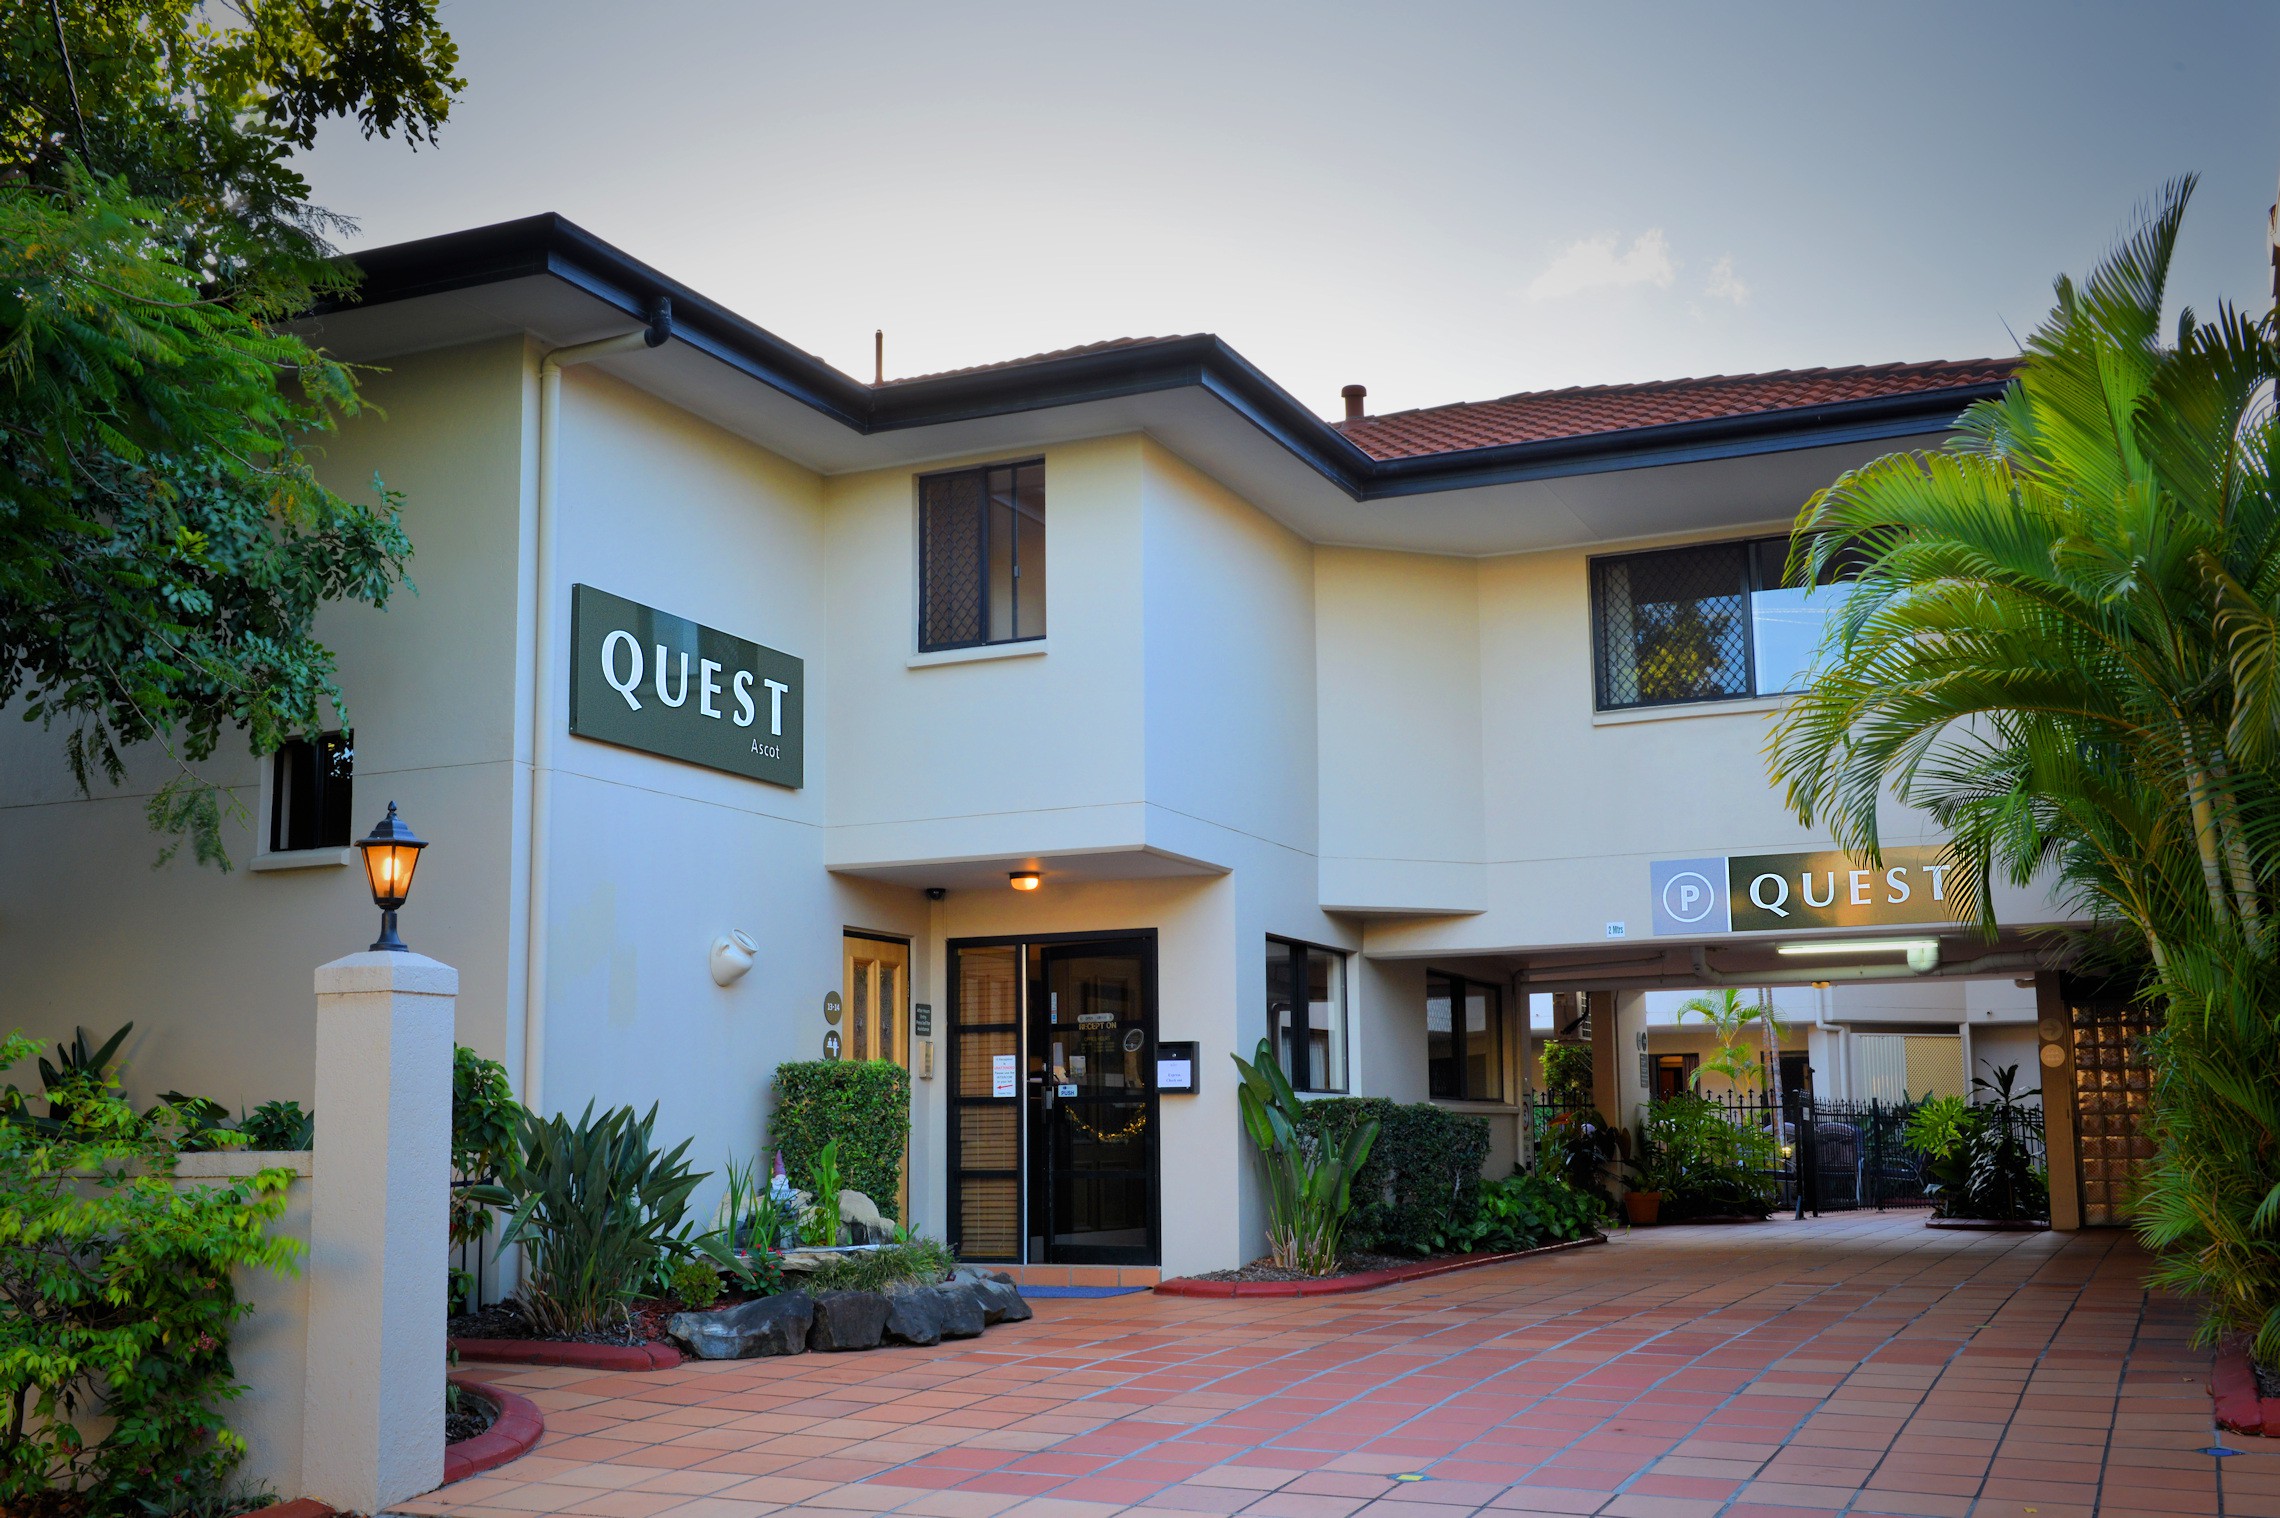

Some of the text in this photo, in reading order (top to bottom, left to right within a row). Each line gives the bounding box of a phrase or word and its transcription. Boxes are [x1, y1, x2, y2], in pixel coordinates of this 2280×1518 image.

[602, 630, 788, 735] QUEST
[750, 738, 780, 759] Ascot
[1680, 885, 1700, 912] P
[1749, 864, 1951, 918] QUEST
[1608, 925, 1612, 934] 2
[1079, 1021, 1117, 1031] RECEPTON
